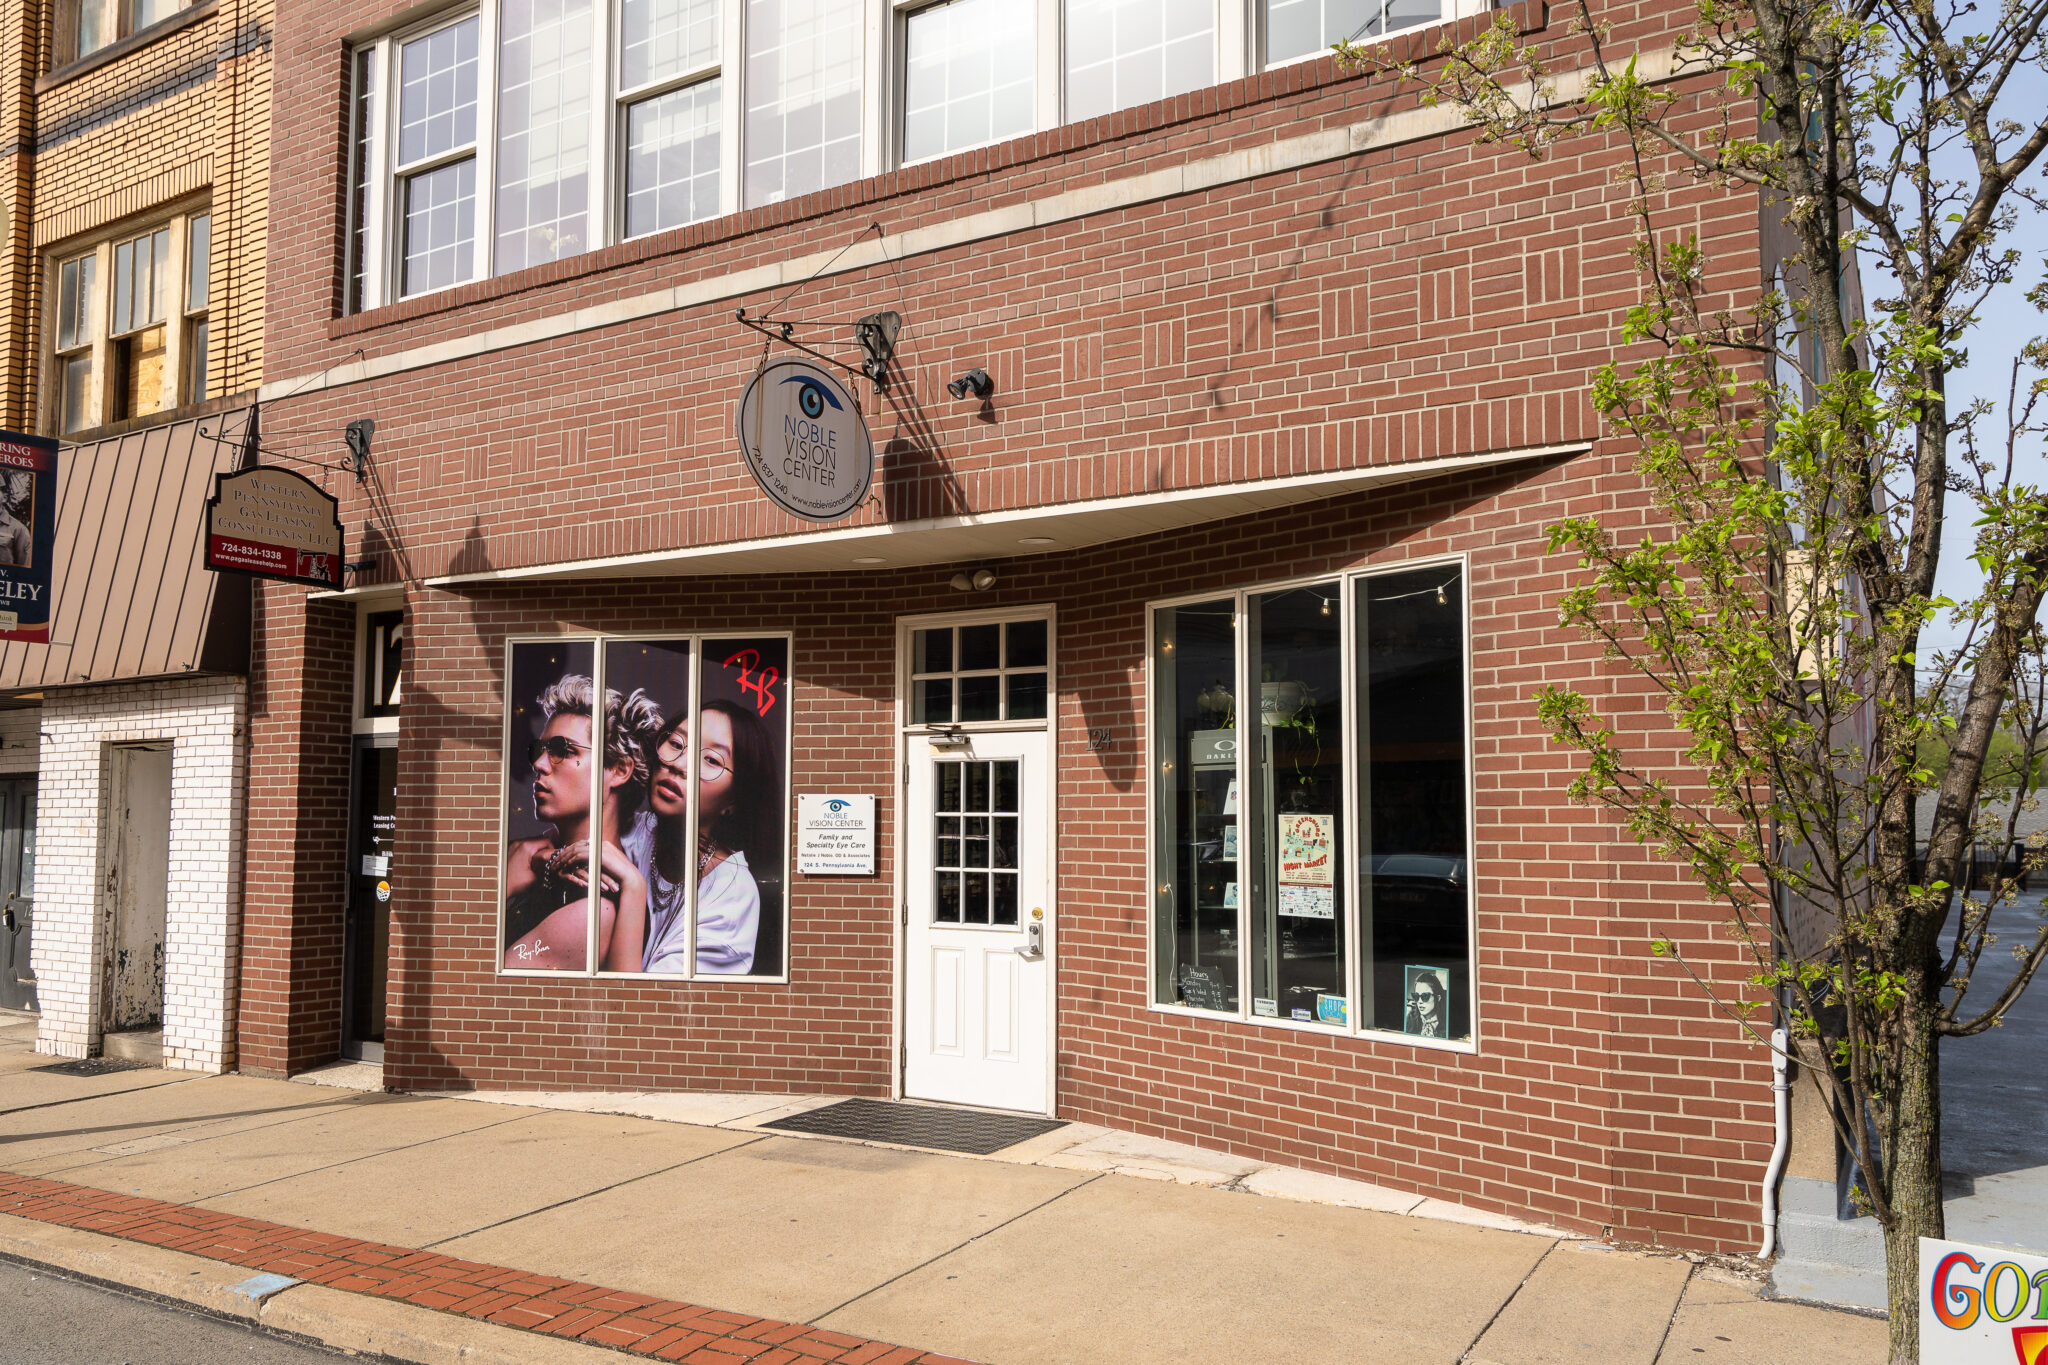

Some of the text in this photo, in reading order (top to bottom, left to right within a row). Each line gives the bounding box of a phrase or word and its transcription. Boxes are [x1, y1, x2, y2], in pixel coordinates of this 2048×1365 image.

[784, 414, 836, 449] NOBLE
[784, 435, 836, 469] VISION
[752, 445, 788, 495] 724-837-1240
[783, 457, 835, 488] CENTER
[250, 478, 307, 500] WESTERN
[791, 478, 862, 510] www.noblevisioncenter.com
[234, 490, 321, 516] PENNSYLVANIA
[240, 506, 315, 529] GAS LEASING
[221, 542, 282, 560] 724-834-1338
[309, 533, 335, 547] LLC
[723, 648, 778, 717] RB
[1085, 728, 1112, 751] 124
[1283, 862, 1302, 871] NIGHT
[1304, 854, 1327, 868] MARKET
[513, 939, 550, 960] Ray-Ban
[1190, 967, 1209, 979] Hours
